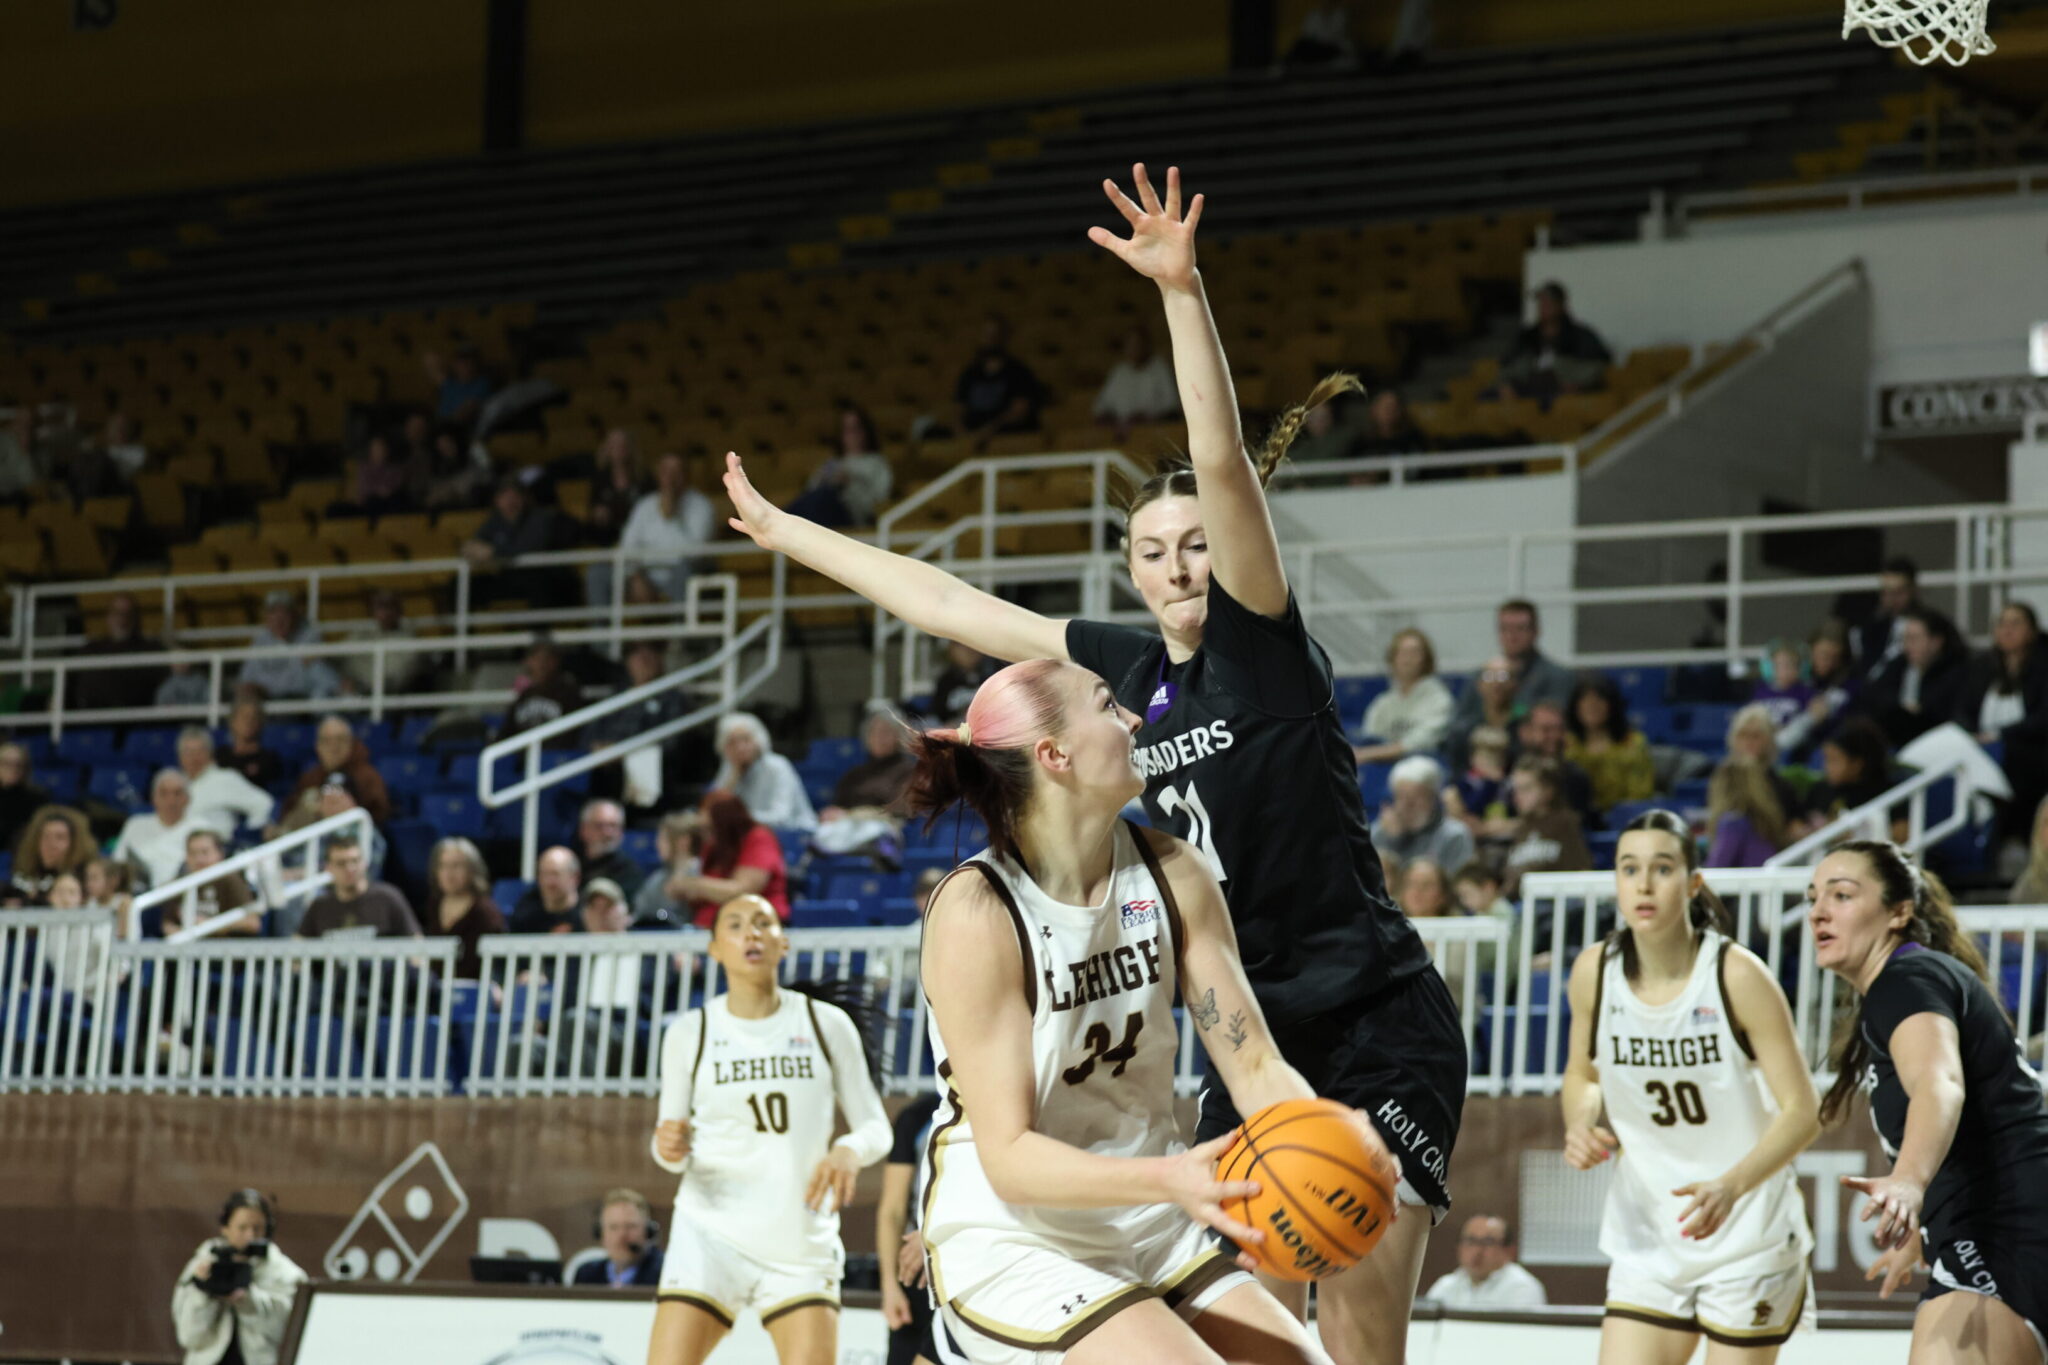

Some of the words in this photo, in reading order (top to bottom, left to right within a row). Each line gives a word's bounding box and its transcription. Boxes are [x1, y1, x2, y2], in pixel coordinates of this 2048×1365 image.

[1157, 780, 1228, 881] 21
[714, 1055, 813, 1085] LEHIGH
[1062, 1010, 1144, 1086] 34
[1611, 1033, 1722, 1067] LEHIGH
[747, 1092, 789, 1134] 10
[1376, 1098, 1429, 1153] HOLY
[1644, 1080, 1708, 1127] 30
